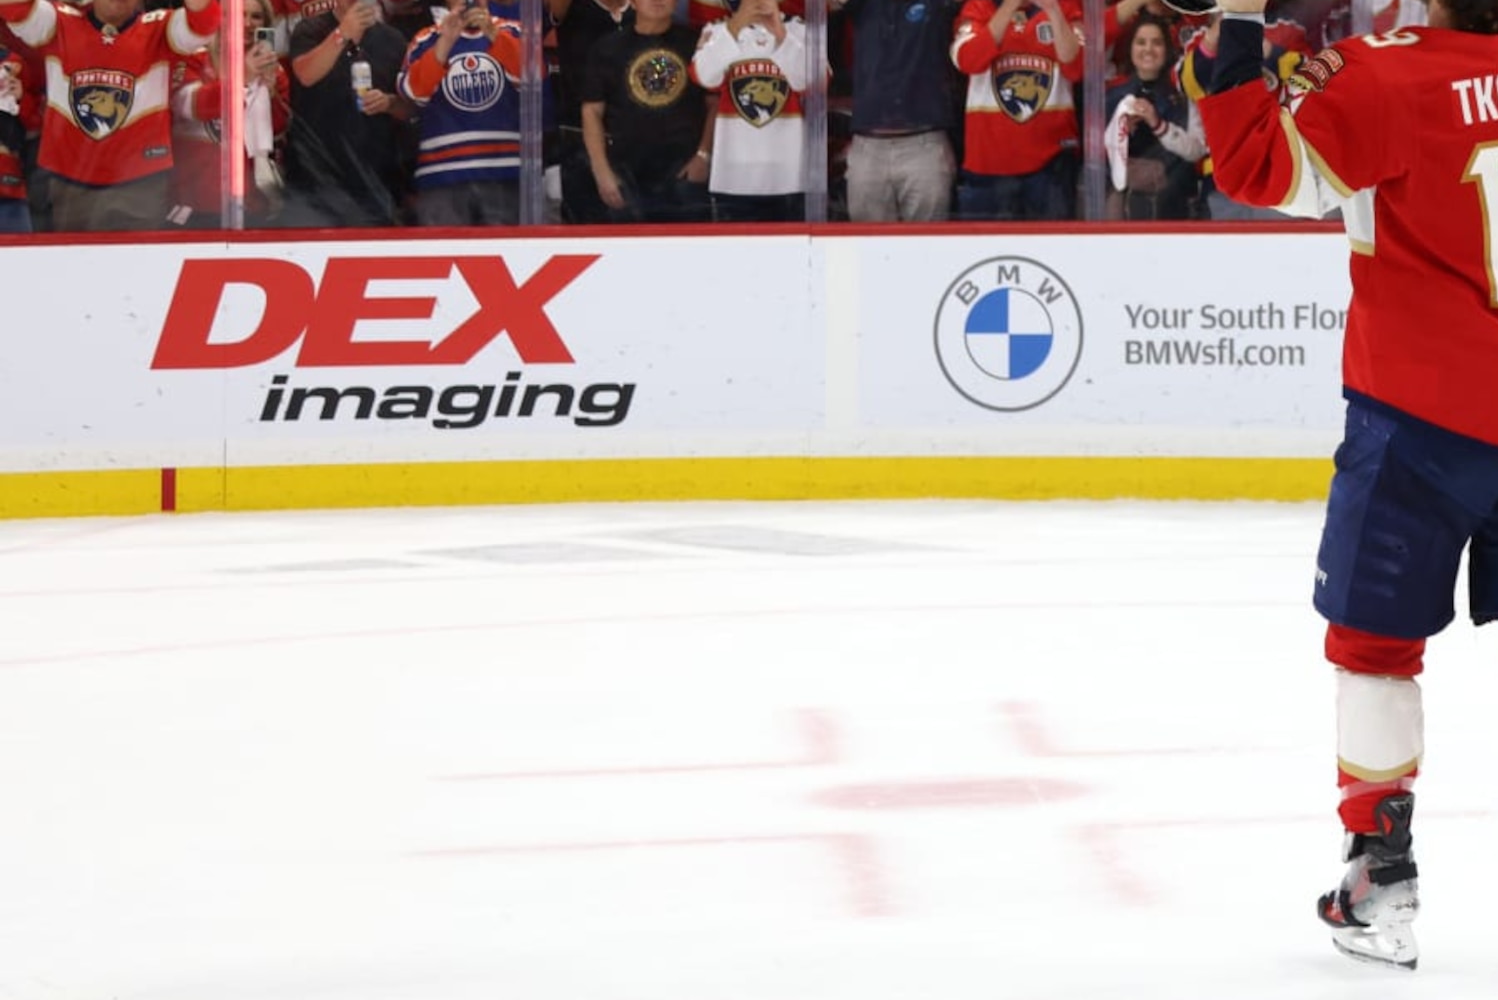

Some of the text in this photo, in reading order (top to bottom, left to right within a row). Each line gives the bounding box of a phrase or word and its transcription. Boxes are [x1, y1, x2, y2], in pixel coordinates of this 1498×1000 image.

[75, 70, 131, 88] PANTHERS
[451, 68, 496, 106] OILERS
[150, 253, 603, 370] DEX
[1124, 304, 1193, 330] Your
[1200, 303, 1285, 331] South
[1124, 340, 1306, 367] BMWsfl.com
[259, 371, 636, 430] imaging
